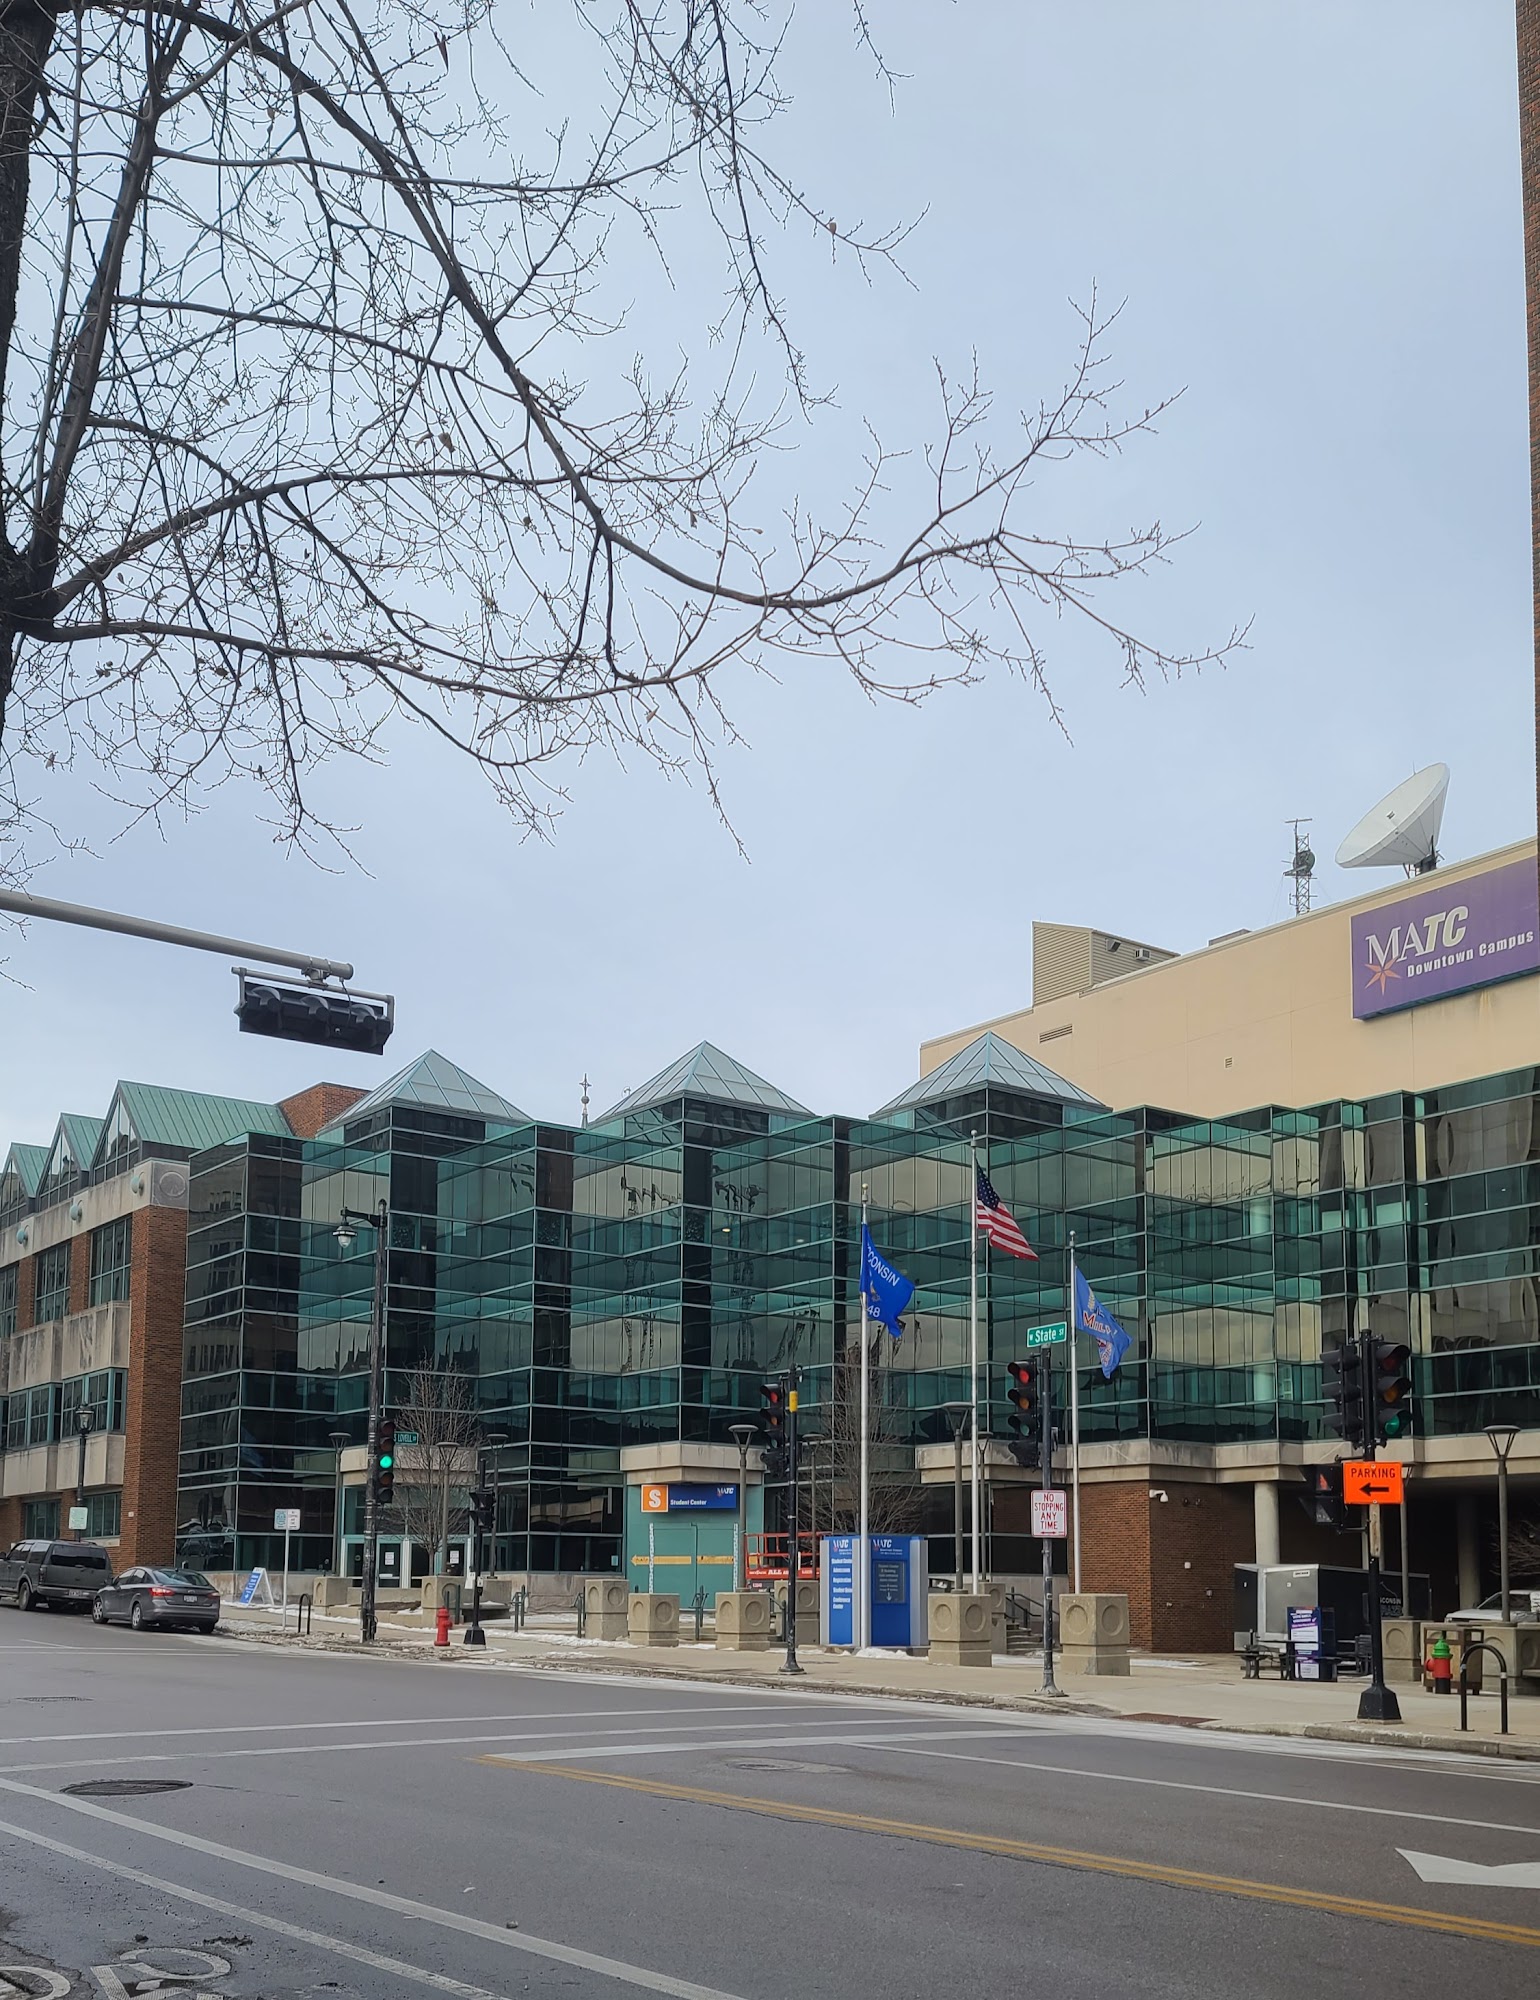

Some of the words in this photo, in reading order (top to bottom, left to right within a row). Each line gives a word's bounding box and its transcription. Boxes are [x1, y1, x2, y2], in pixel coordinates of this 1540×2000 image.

[1365, 906, 1468, 967] MATC
[1407, 948, 1474, 977] Downtown
[1479, 931, 1534, 957] Campus
[867, 1305, 881, 1318] 48
[1035, 1328, 1057, 1343] State
[1350, 1468, 1396, 1478] PARKING
[648, 1489, 661, 1508] S
[1043, 1494, 1055, 1502] NO
[1034, 1503, 1063, 1511] STOPPING
[1041, 1512, 1057, 1520] ANY
[1040, 1521, 1058, 1529] TIME
